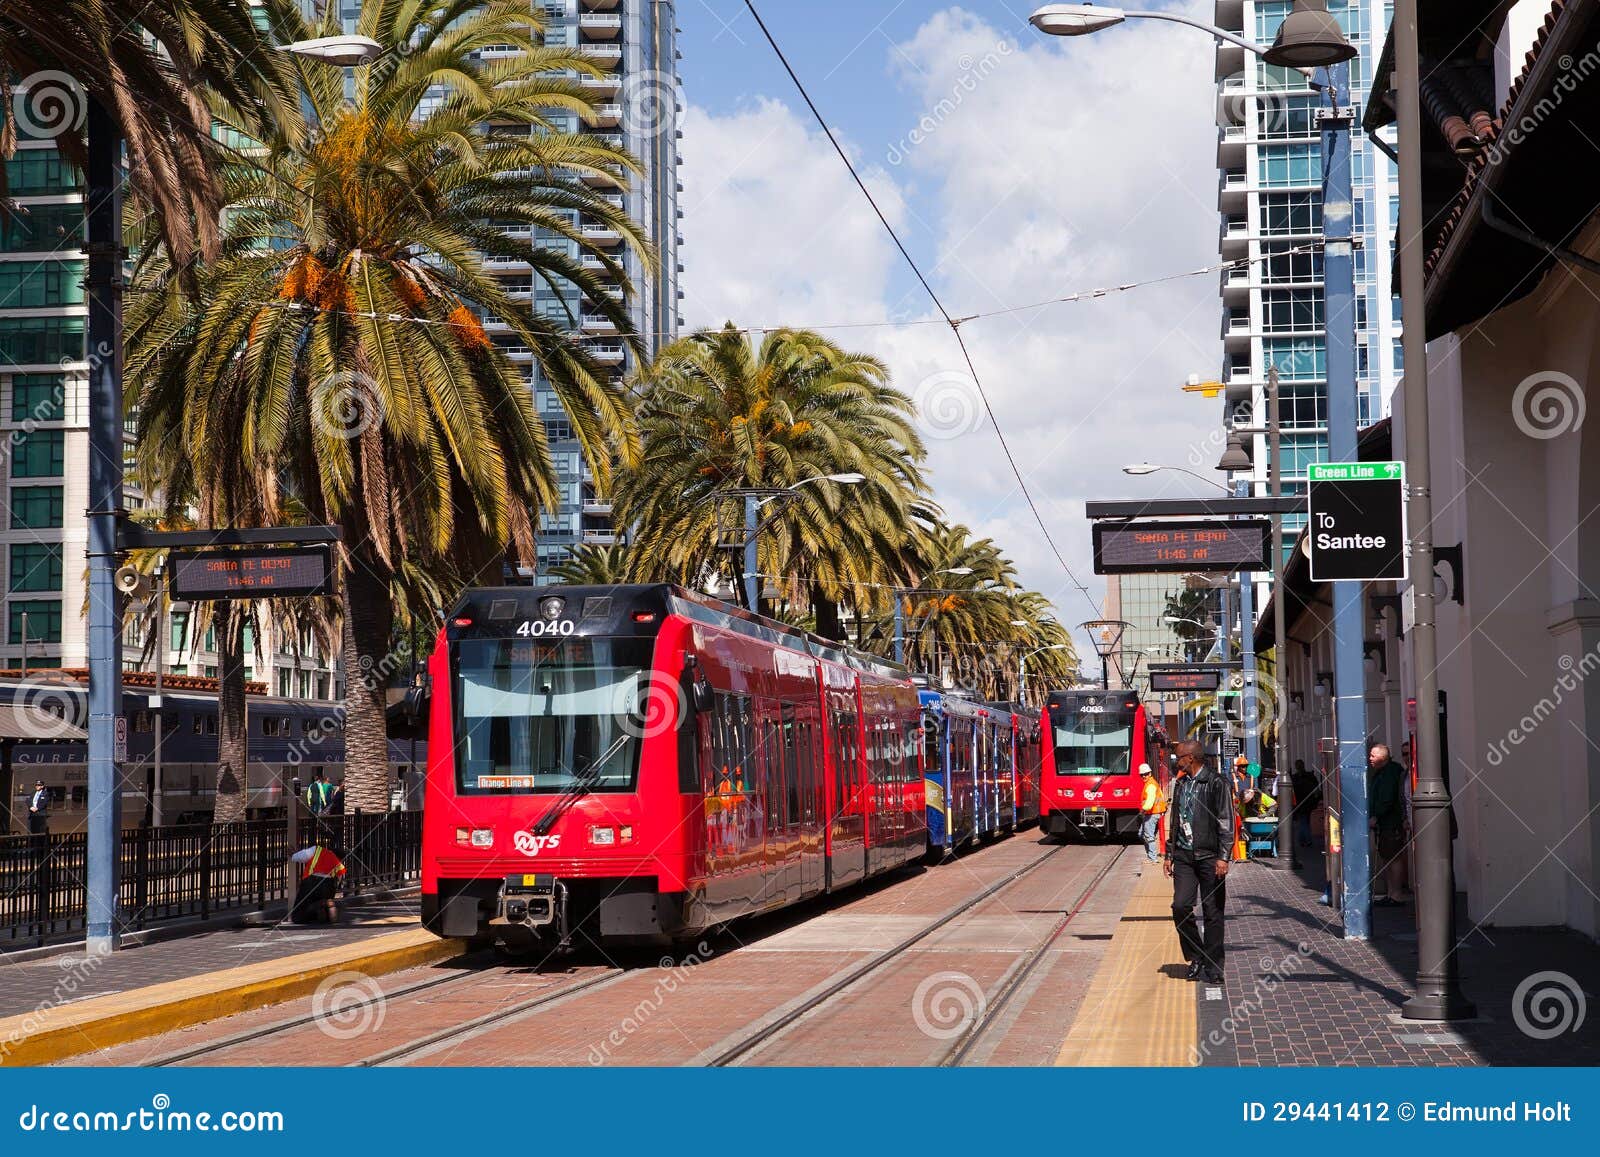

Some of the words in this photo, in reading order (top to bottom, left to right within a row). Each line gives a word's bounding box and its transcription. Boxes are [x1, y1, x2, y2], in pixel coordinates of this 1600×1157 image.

[1315, 466, 1348, 478] Green
[1350, 465, 1375, 477] Line
[1315, 512, 1335, 529] To
[1135, 532, 1169, 544] SANTA
[1174, 532, 1188, 543] FE
[1194, 531, 1228, 543] DEPOT
[1317, 533, 1386, 550] Santee
[1157, 549, 1186, 560] 11:46
[1193, 548, 1208, 559] AM
[207, 560, 238, 571] SANTA
[243, 560, 256, 571] FE
[261, 558, 293, 570] DEPOT
[228, 575, 255, 586] 11:46
[261, 575, 274, 585] AM
[516, 619, 575, 637] 4040
[481, 778, 505, 788] Orange
[506, 777, 521, 788] Line
[514, 833, 561, 853] MTS
